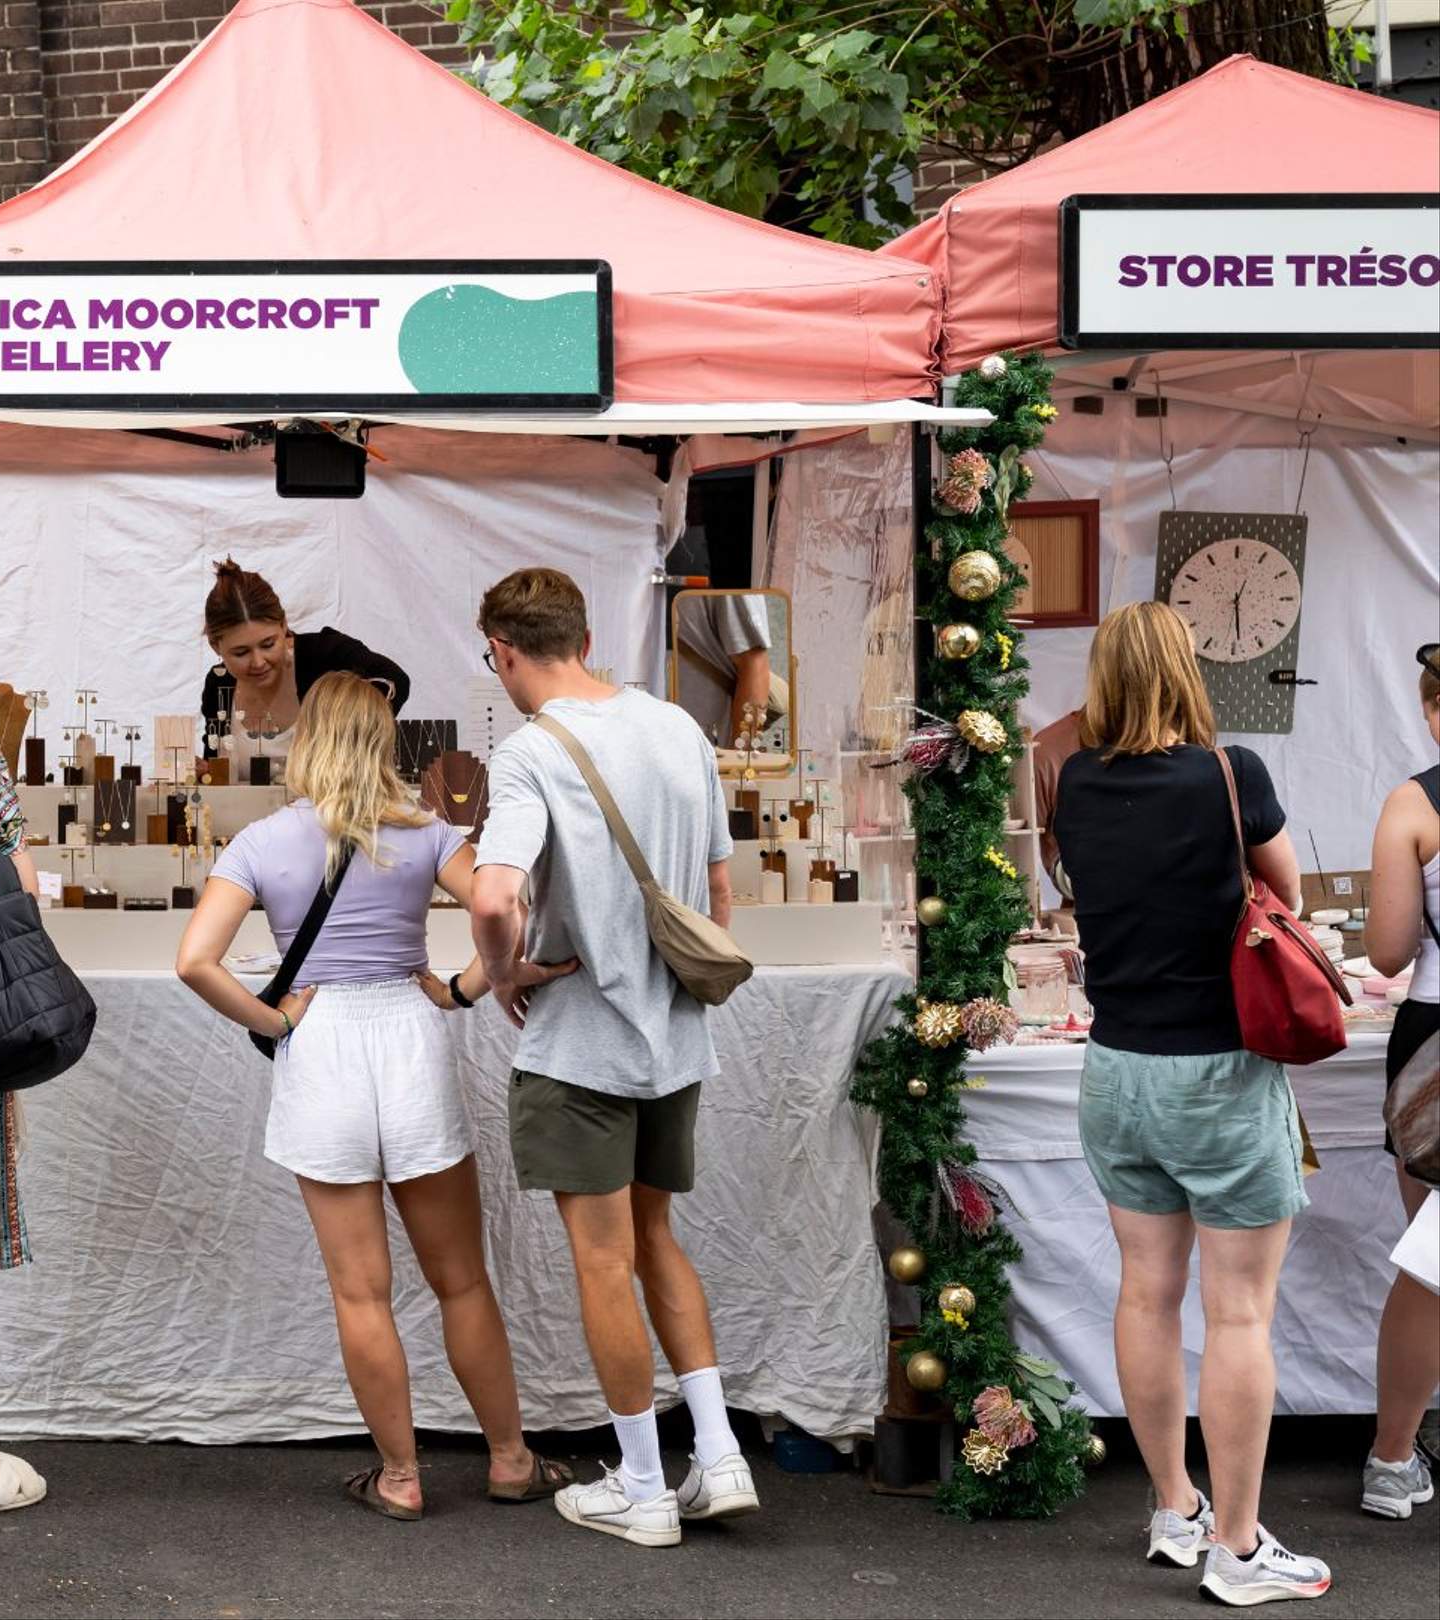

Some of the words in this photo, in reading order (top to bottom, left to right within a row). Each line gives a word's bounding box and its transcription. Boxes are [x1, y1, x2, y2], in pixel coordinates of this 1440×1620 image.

[1118, 255, 1274, 287] STORE
[1286, 246, 1440, 287] TRÉSO
[88, 298, 380, 329] MOORCROFT
